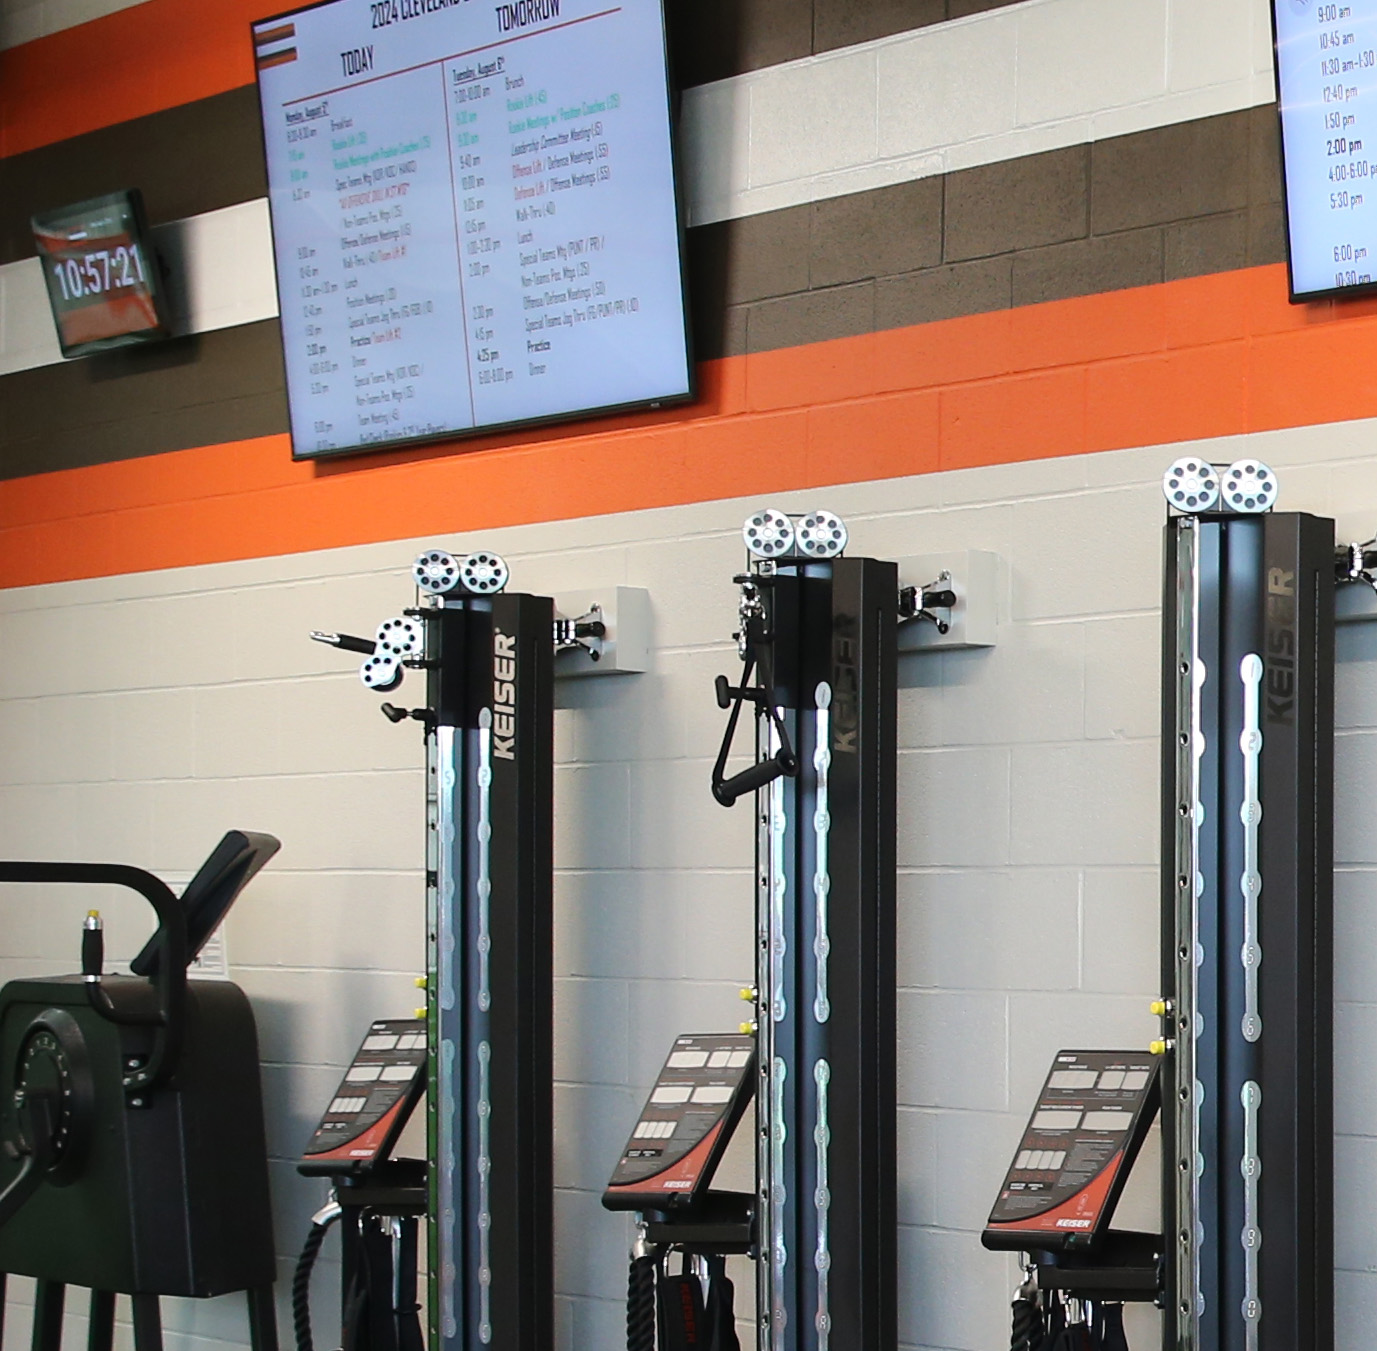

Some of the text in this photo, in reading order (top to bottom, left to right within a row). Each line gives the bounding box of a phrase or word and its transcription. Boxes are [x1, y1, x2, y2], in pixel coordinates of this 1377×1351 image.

[371, 1, 399, 29] 2024
[495, 0, 560, 32] TOMORROW
[1318, 5, 1351, 23] 9:00 am
[1320, 31, 1354, 50] 10:45 am
[341, 45, 374, 77] TODAY
[1321, 57, 1340, 76] 11:30
[1323, 84, 1358, 102] 12:40 pm
[1325, 112, 1355, 130] 1:50 pm
[1327, 138, 1362, 156] 2:00 pm
[1328, 160, 1369, 182] 4:00-6:00
[1330, 192, 1363, 210] 5:30 pm
[1334, 244, 1367, 263] 6:00 pm
[54, 244, 144, 300] 10:57:21
[527, 340, 551, 353] Practice
[493, 633, 517, 761] KEISER
[1056, 1219, 1092, 1228] KEISER
